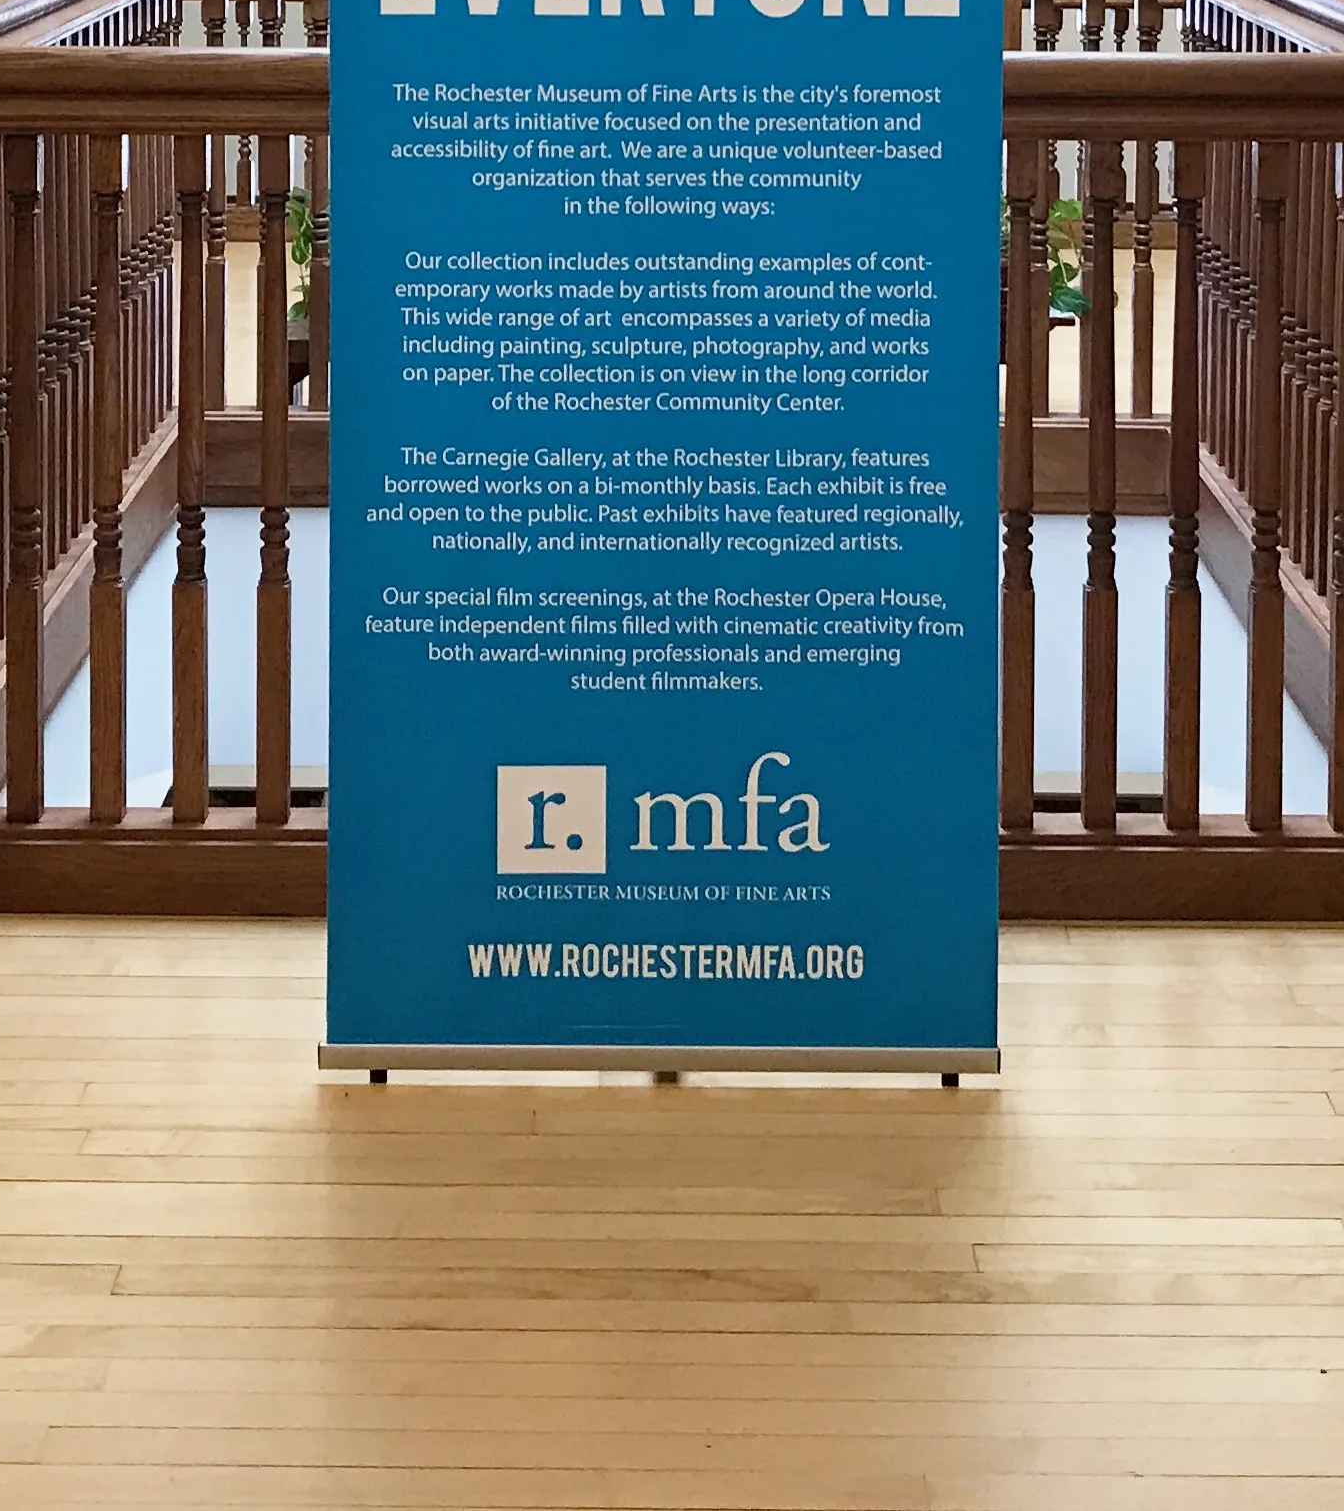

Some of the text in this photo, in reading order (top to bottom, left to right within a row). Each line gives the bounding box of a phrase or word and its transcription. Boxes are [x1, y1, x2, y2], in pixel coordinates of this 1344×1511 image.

[392, 83, 942, 107] The Rochester Museum of Fine Arts is the city's foremost
[412, 111, 921, 135] visual arts initiative focused on the presentation and
[391, 139, 942, 163] accessibility of fine art. We are a unique volunteer-based
[472, 168, 862, 191] organization that serves the community
[564, 195, 775, 219] in the following ways:
[405, 250, 932, 276] Our collection includes outstanding examples of cont-
[394, 279, 938, 303] emporary works made by artists from around the world.
[400, 307, 931, 332] This wide range of art encompasses a variety of media
[403, 334, 930, 360] including painting, sculpture, photography, and works
[402, 363, 929, 387] on paper. The collection is on view in the long corridor
[491, 391, 845, 415] of the Rochester Community Center.
[400, 446, 930, 471] The Carnegie Gallery, at the Rochester Library, features
[384, 474, 947, 499] borrowed works on a bi-monthly basis. Each exhibit is free
[366, 502, 964, 529] and open to the public. Past exhibits have featured regionally,
[432, 531, 903, 556] nationally, and internationally recognized artists.
[382, 586, 946, 611] Our special film screenings, at the Rochester Opera House,
[365, 614, 964, 639] feature independent films filled with cinematic creativity from
[428, 642, 901, 667] both award-winning professionals and emerging
[571, 671, 763, 691] student filmmakers.
[630, 751, 831, 853] mfa
[496, 883, 831, 901] ROCHESTER MUSEUM OF FINE ARTS
[467, 943, 864, 980] WWW.ROCHESTERMFA.ORG
